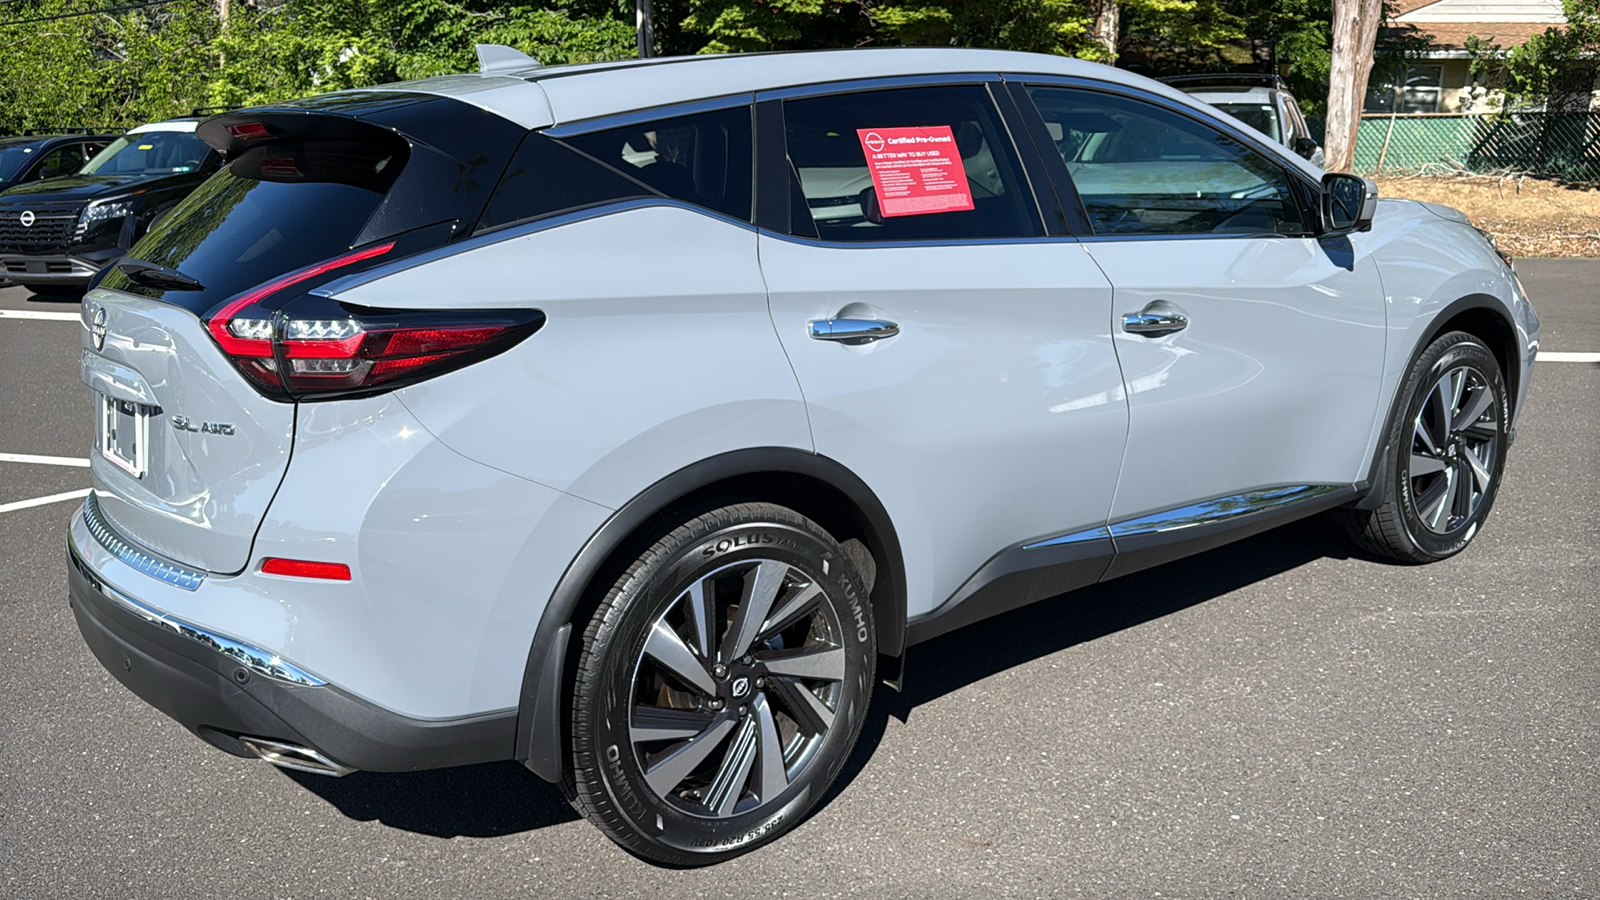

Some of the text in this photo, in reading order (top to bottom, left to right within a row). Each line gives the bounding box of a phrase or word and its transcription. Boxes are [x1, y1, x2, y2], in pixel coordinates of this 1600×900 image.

[887, 135, 951, 145] Certified Pre-Owned
[172, 414, 236, 436] SL AWD
[702, 534, 774, 560] SOLUS
[838, 573, 867, 643] KUMHO
[606, 744, 647, 820] KUMHO
[690, 837, 718, 847] 102V
[722, 834, 744, 846] R20
